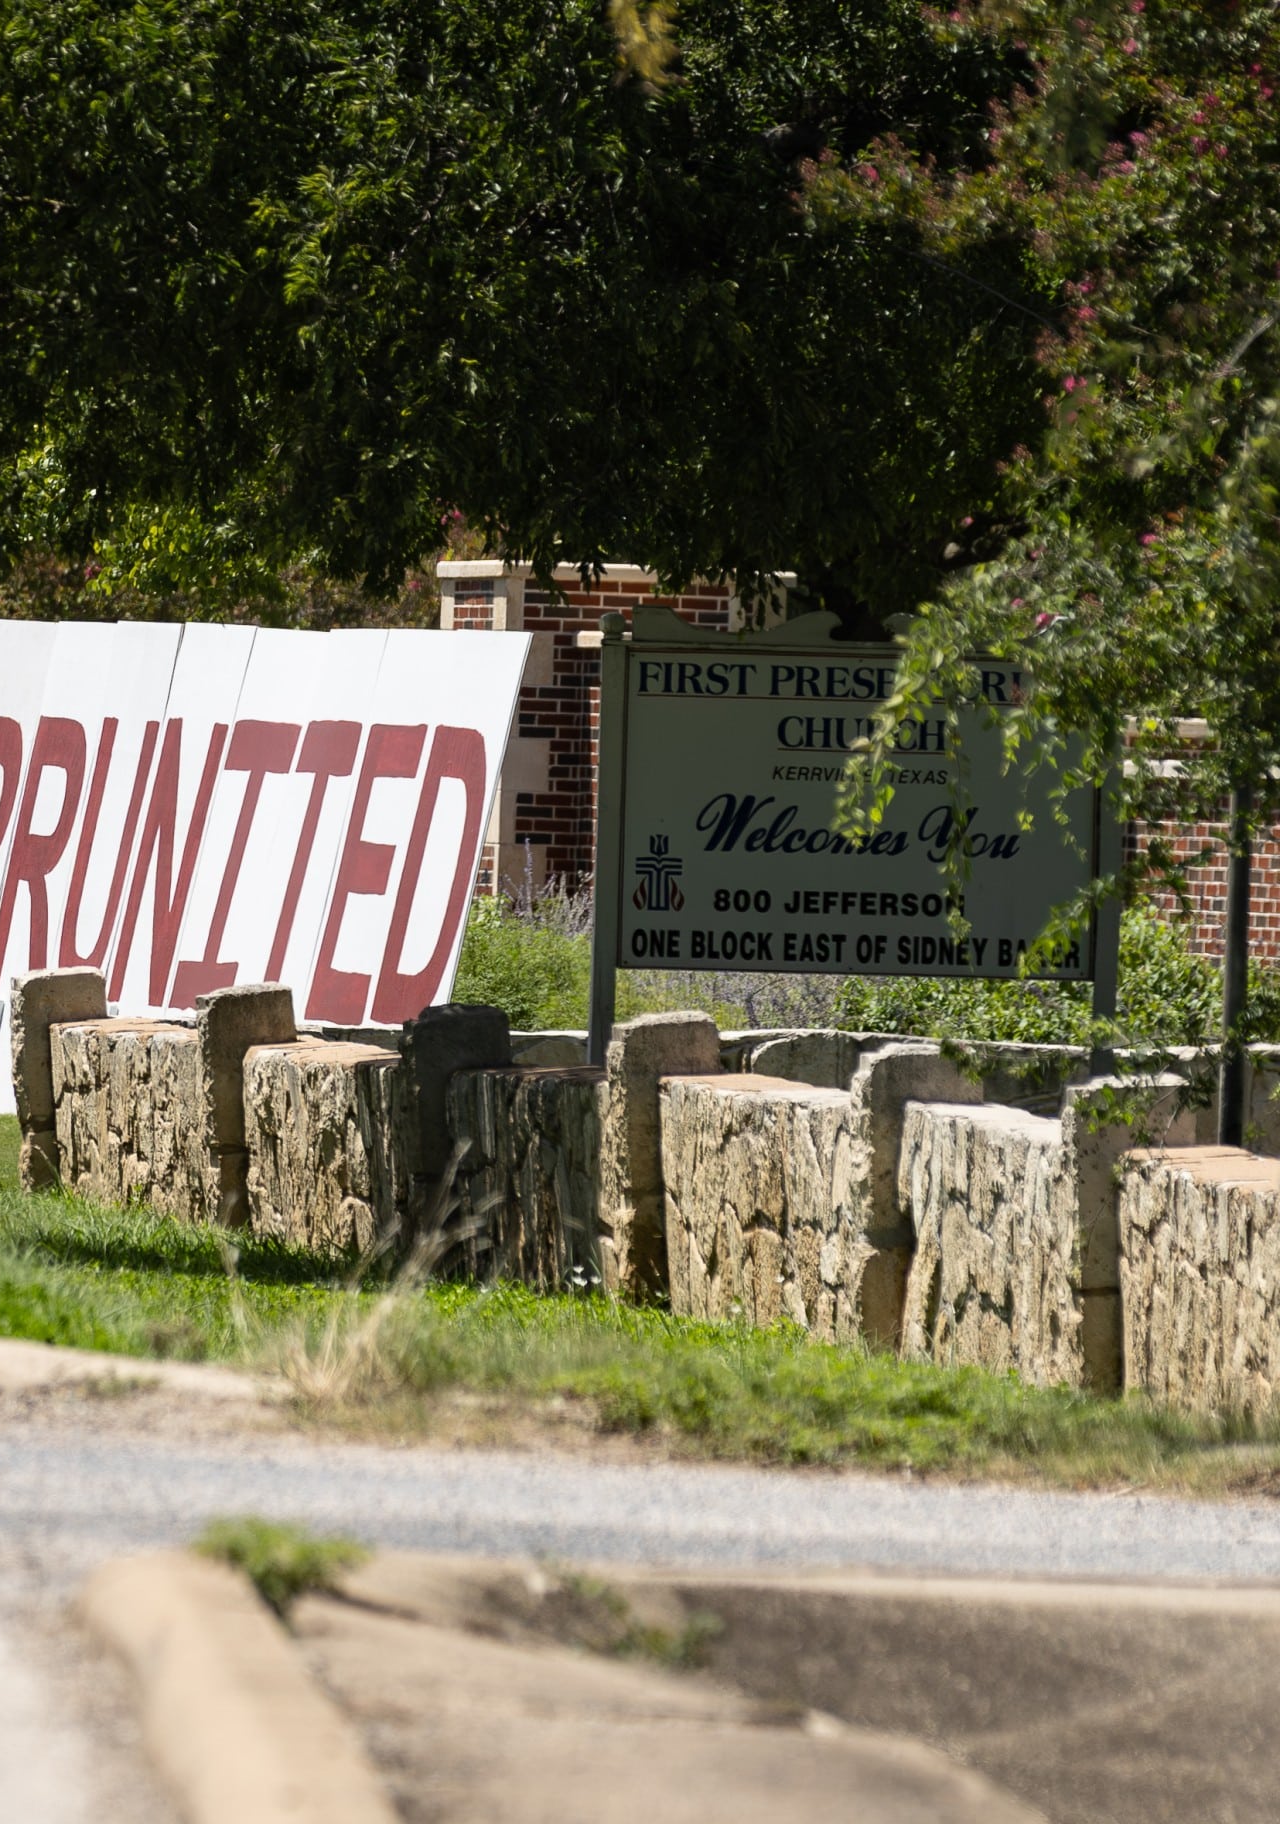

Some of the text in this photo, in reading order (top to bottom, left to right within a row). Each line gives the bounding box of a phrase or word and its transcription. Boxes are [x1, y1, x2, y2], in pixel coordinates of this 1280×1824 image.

[637, 661, 757, 696] FIRST
[918, 804, 1021, 864] You
[713, 889, 772, 913] 800
[631, 929, 681, 959] ONE
[690, 931, 773, 961] BLOCK
[784, 933, 847, 963] EAST
[856, 934, 887, 965] OF
[897, 936, 990, 967] SIDNEY
